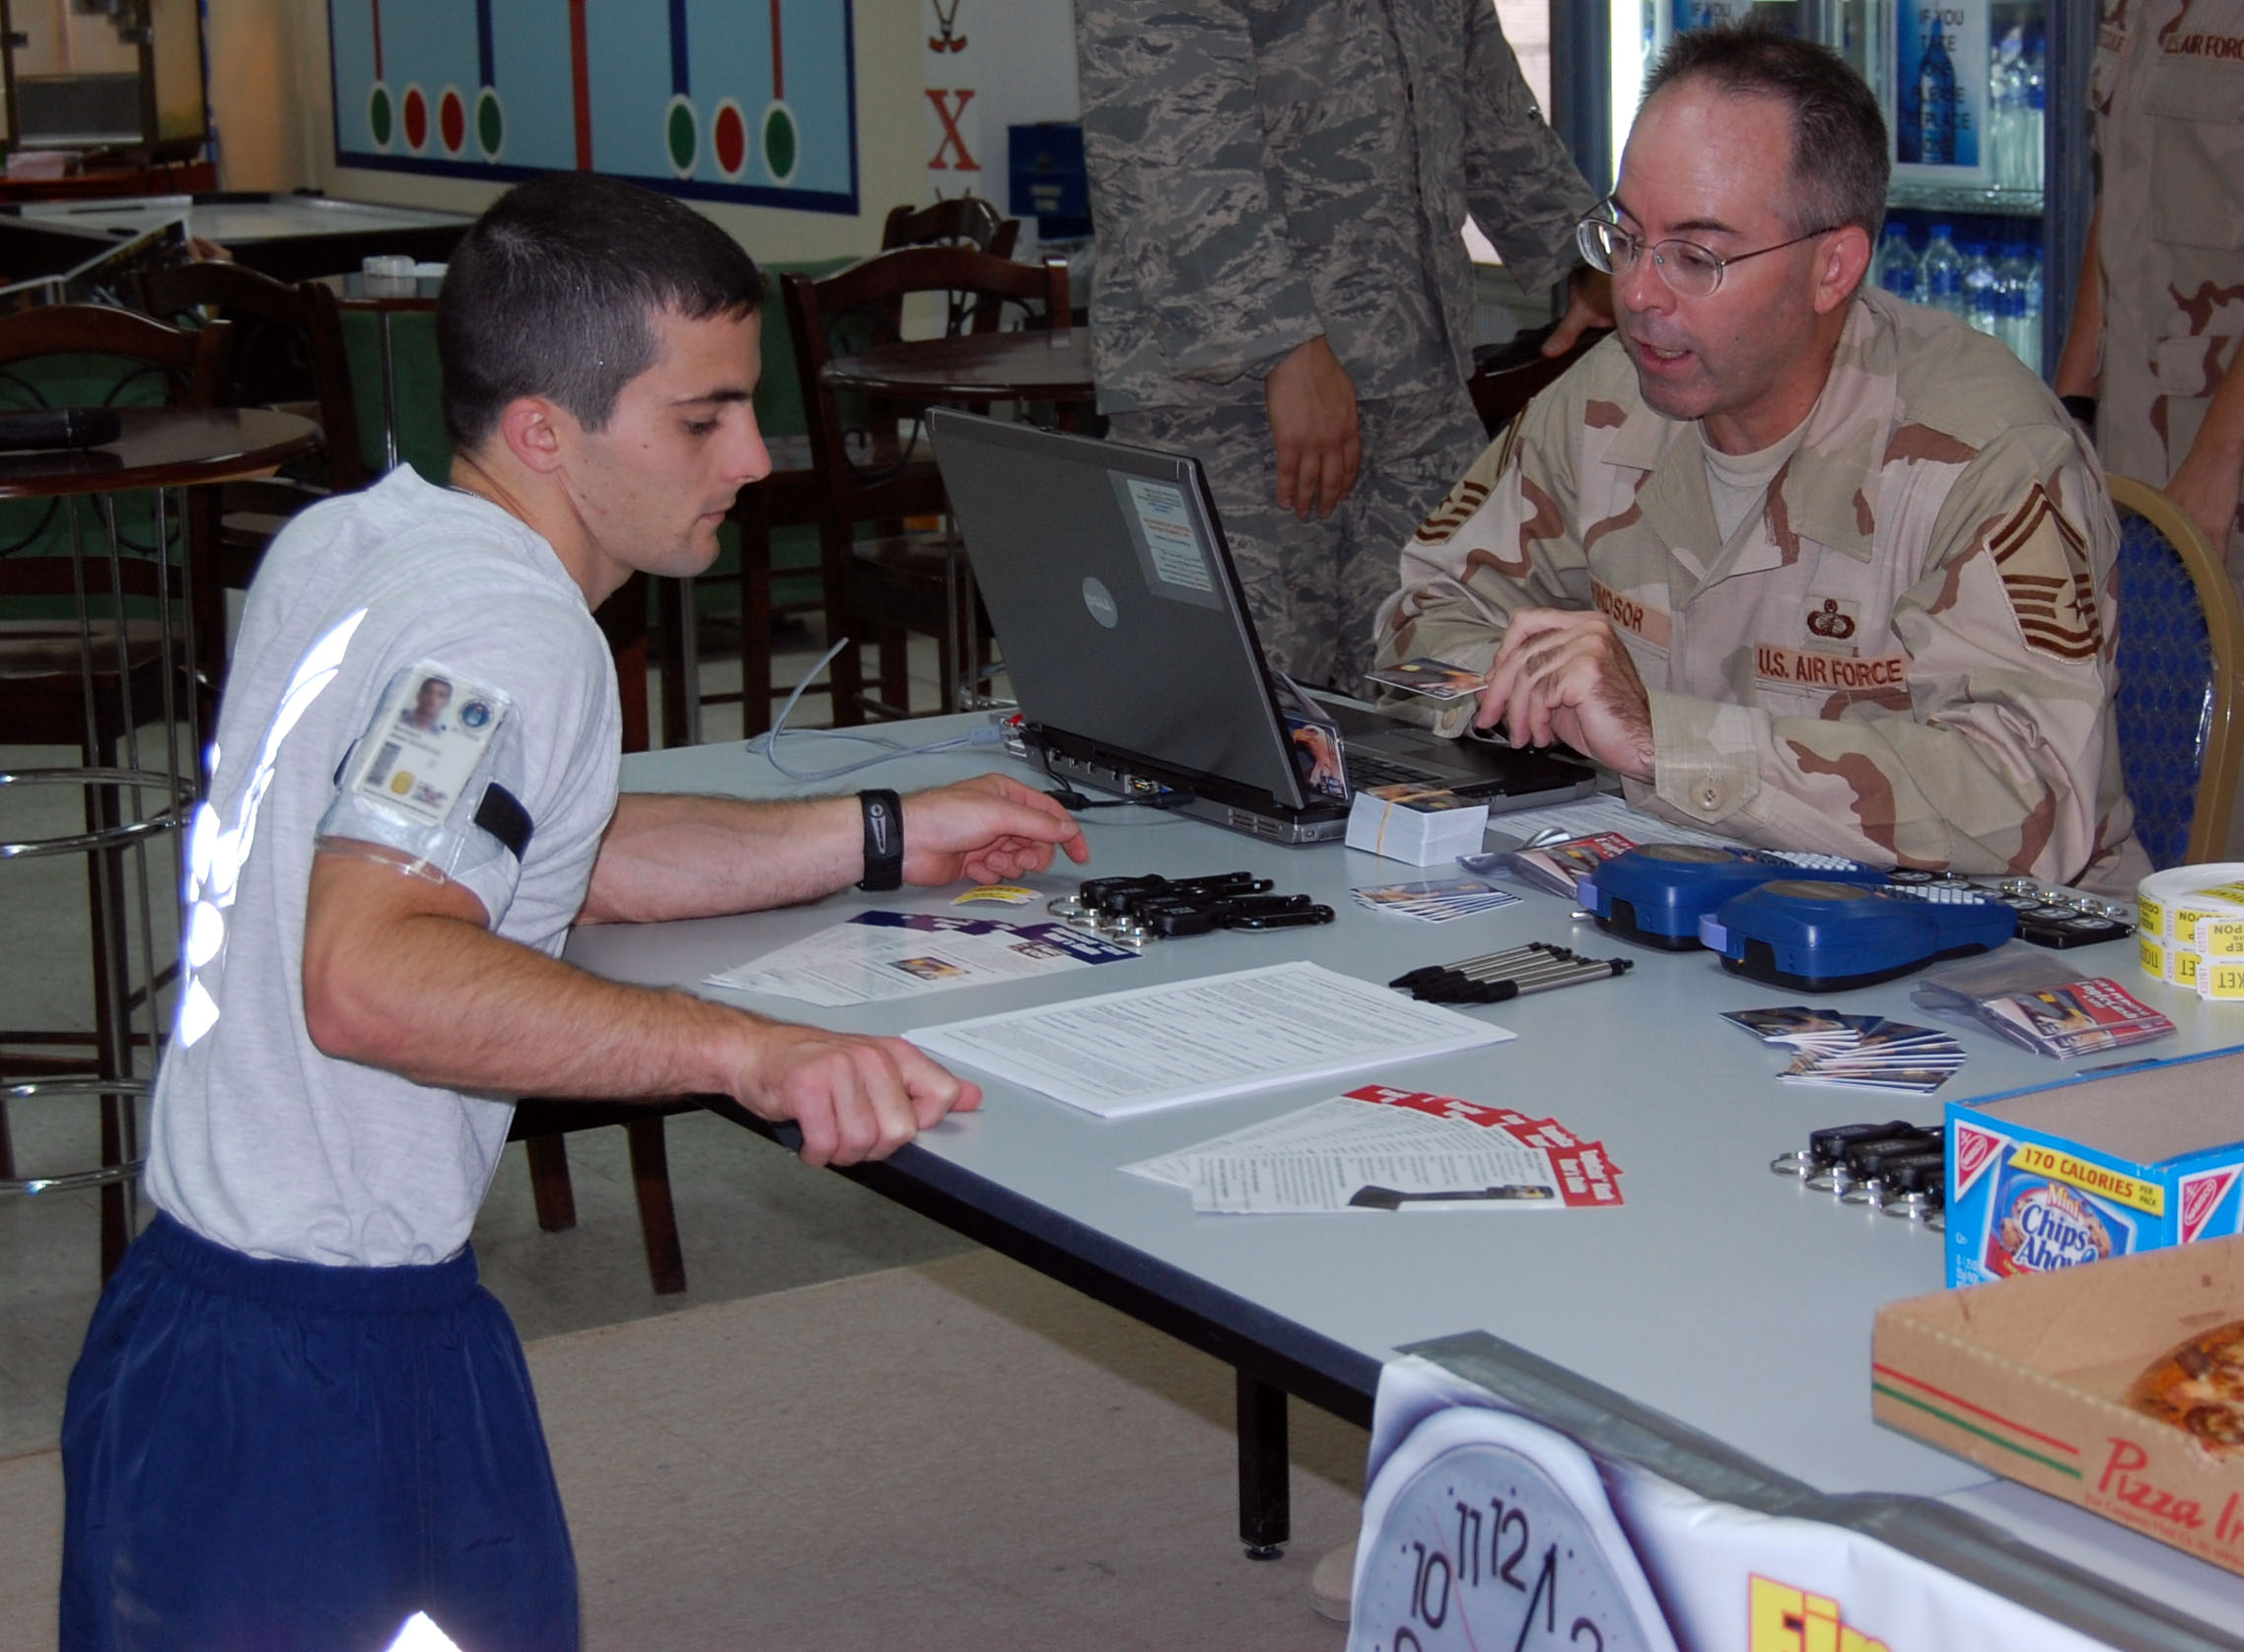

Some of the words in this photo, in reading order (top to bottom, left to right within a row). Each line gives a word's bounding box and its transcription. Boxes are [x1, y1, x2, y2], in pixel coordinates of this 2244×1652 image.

[1933, 9, 1964, 27] YOU
[2180, 34, 2204, 55] AIR
[925, 89, 981, 172] X
[1758, 648, 1790, 679] U.S.
[1795, 655, 1828, 683] AIR
[1831, 658, 1904, 687] FORCE
[2025, 1148, 2055, 1170] 170
[2060, 1159, 2135, 1199] CALORIES
[2139, 1185, 2154, 1196] PER
[2139, 1196, 2157, 1207] PACK
[2021, 1203, 2089, 1252] Chips
[2098, 1436, 2206, 1530] Pizza
[1455, 1500, 1482, 1588] 11
[1491, 1496, 1530, 1593] 12
[1413, 1540, 1452, 1629] 10
